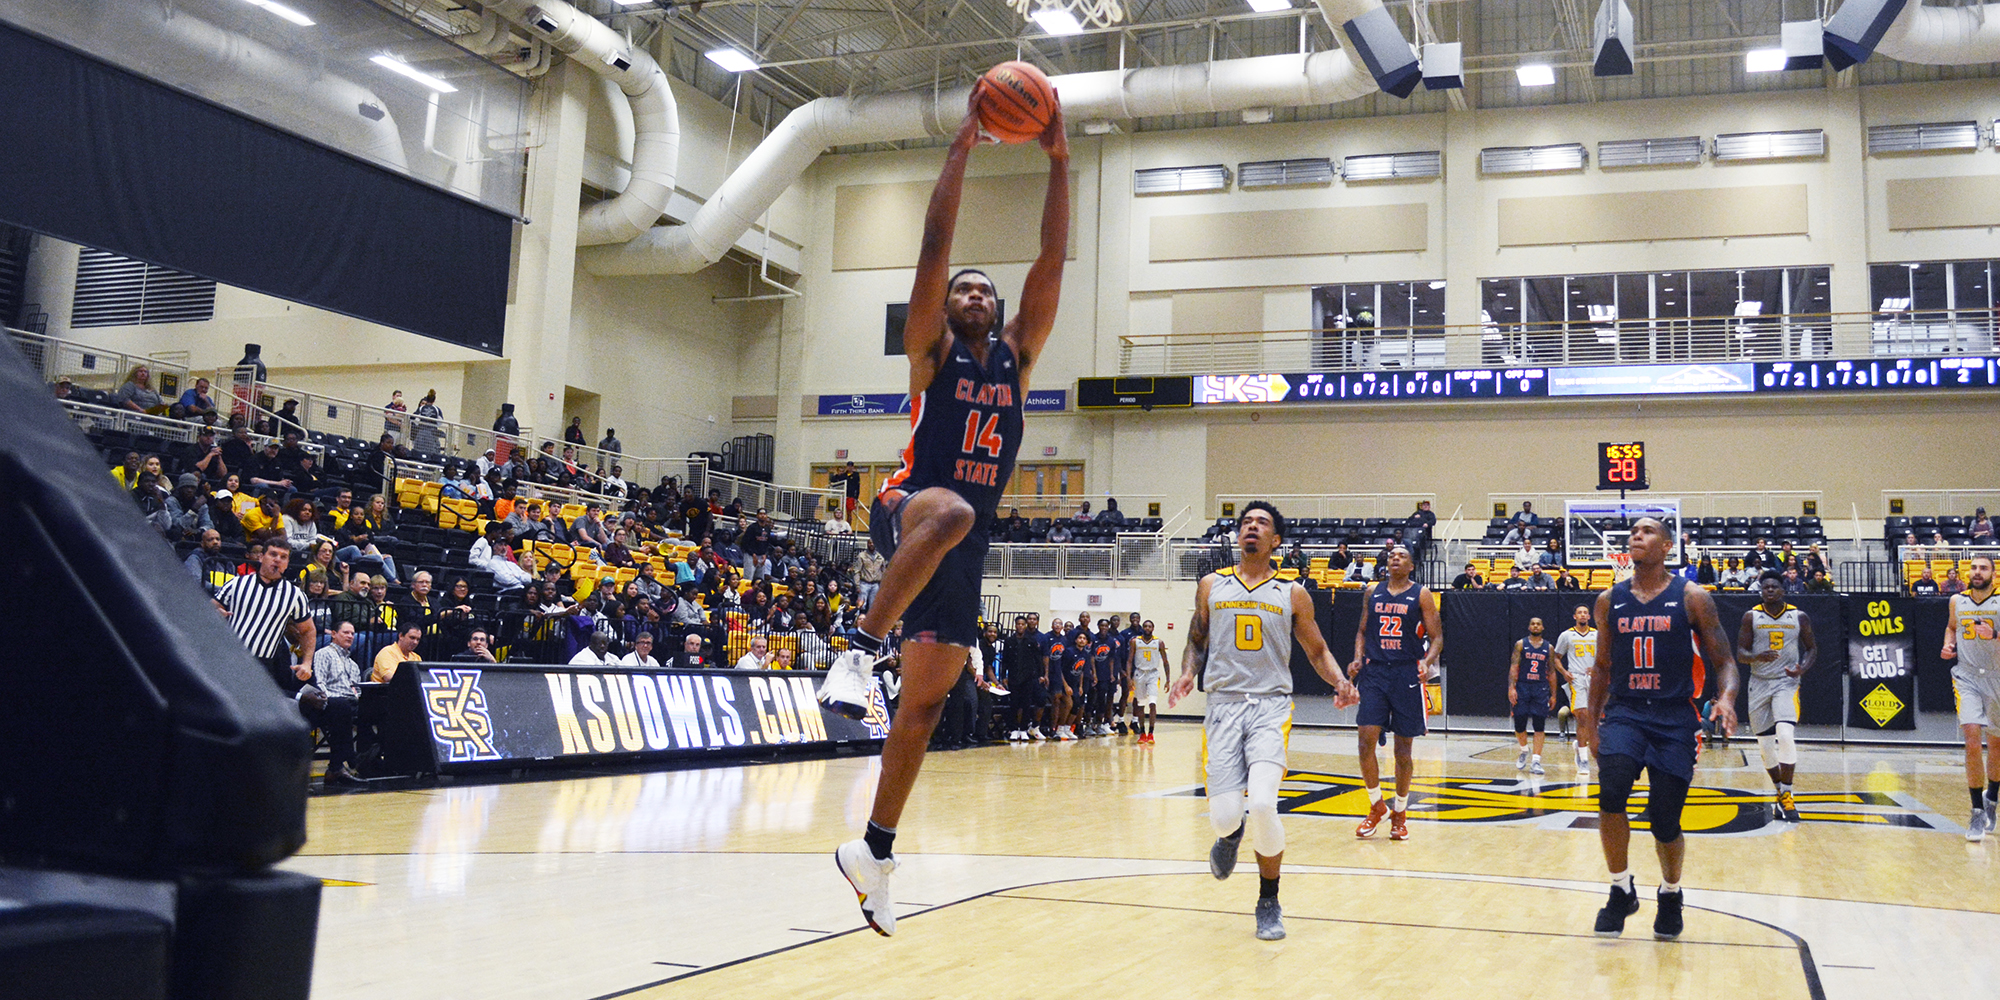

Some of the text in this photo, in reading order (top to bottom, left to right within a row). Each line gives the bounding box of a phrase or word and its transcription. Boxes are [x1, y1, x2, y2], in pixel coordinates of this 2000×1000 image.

[996, 69, 1038, 109] Wilson
[1957, 368, 1970, 382] 2
[1470, 380, 1477, 393] 1
[1520, 379, 1530, 392] 0
[962, 409, 1002, 458] 14
[1606, 445, 1643, 459] 16:55
[954, 458, 998, 486] STATE
[1608, 459, 1637, 482] 28
[1215, 601, 1283, 615] KENNESAW STATE
[1375, 602, 1409, 614] CLAYTON
[1867, 600, 1890, 617] GO
[1379, 616, 1402, 637] 22
[1618, 615, 1671, 633] CLAYTON
[1859, 616, 1904, 636] OWLS
[1235, 614, 1263, 651] 0
[1769, 631, 1785, 650] 5
[1143, 651, 1151, 661] 4
[1575, 644, 1595, 658] 24
[1633, 636, 1654, 669] 11
[1863, 645, 1887, 661] GET
[1530, 661, 1538, 673] 2
[1628, 674, 1661, 689] STATE
[1867, 699, 1896, 708] LOUD
[544, 673, 828, 755] KSUOWLS.COM
